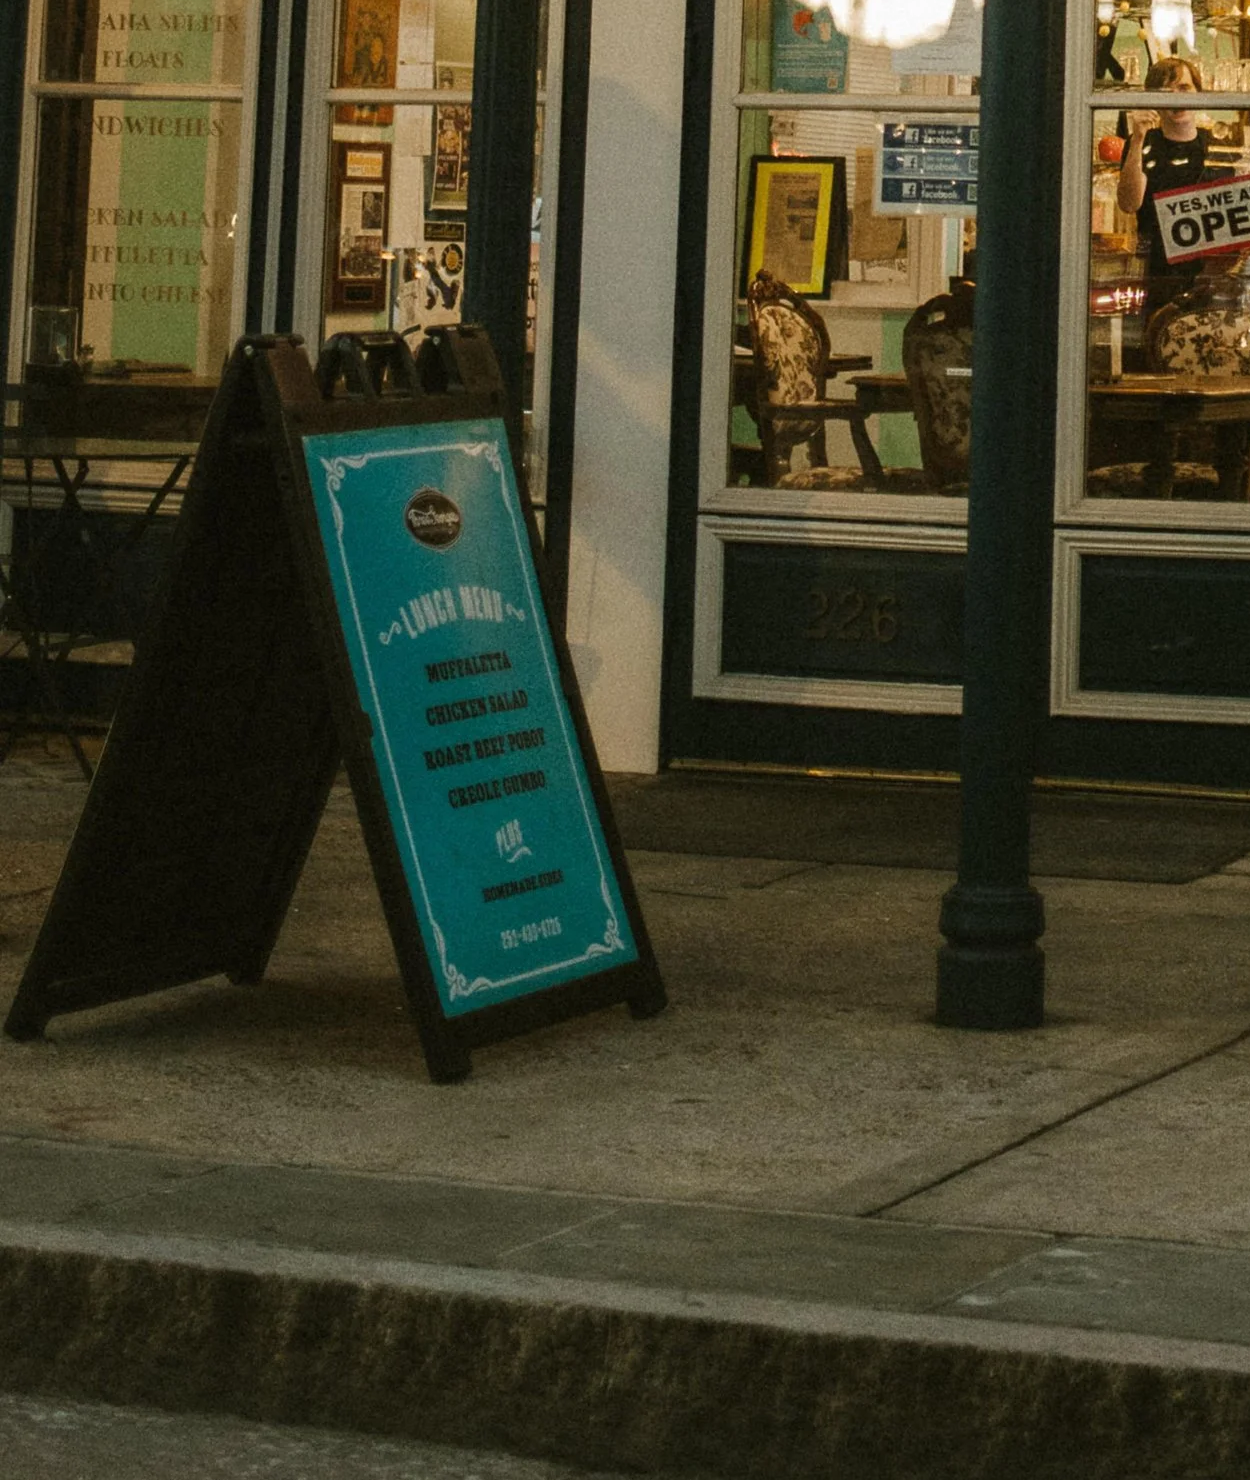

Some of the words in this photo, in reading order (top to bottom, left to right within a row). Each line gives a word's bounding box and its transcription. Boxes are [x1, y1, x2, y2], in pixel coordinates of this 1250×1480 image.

[160, 13, 240, 33] SPLITS
[102, 50, 185, 69] FLOATS
[93, 115, 225, 138] NDWICHES
[151, 209, 228, 229] SALAD
[90, 245, 208, 266] FFULETTA
[399, 588, 457, 639] LUNCH
[459, 584, 504, 624] MENU
[804, 586, 900, 643] 226
[426, 696, 487, 726] CHICKEN
[488, 690, 528, 713] SALAD
[424, 744, 472, 771] ROAST
[474, 735, 505, 759] BEEF
[448, 779, 502, 809] CREOLE
[503, 770, 546, 796] GUMBO
